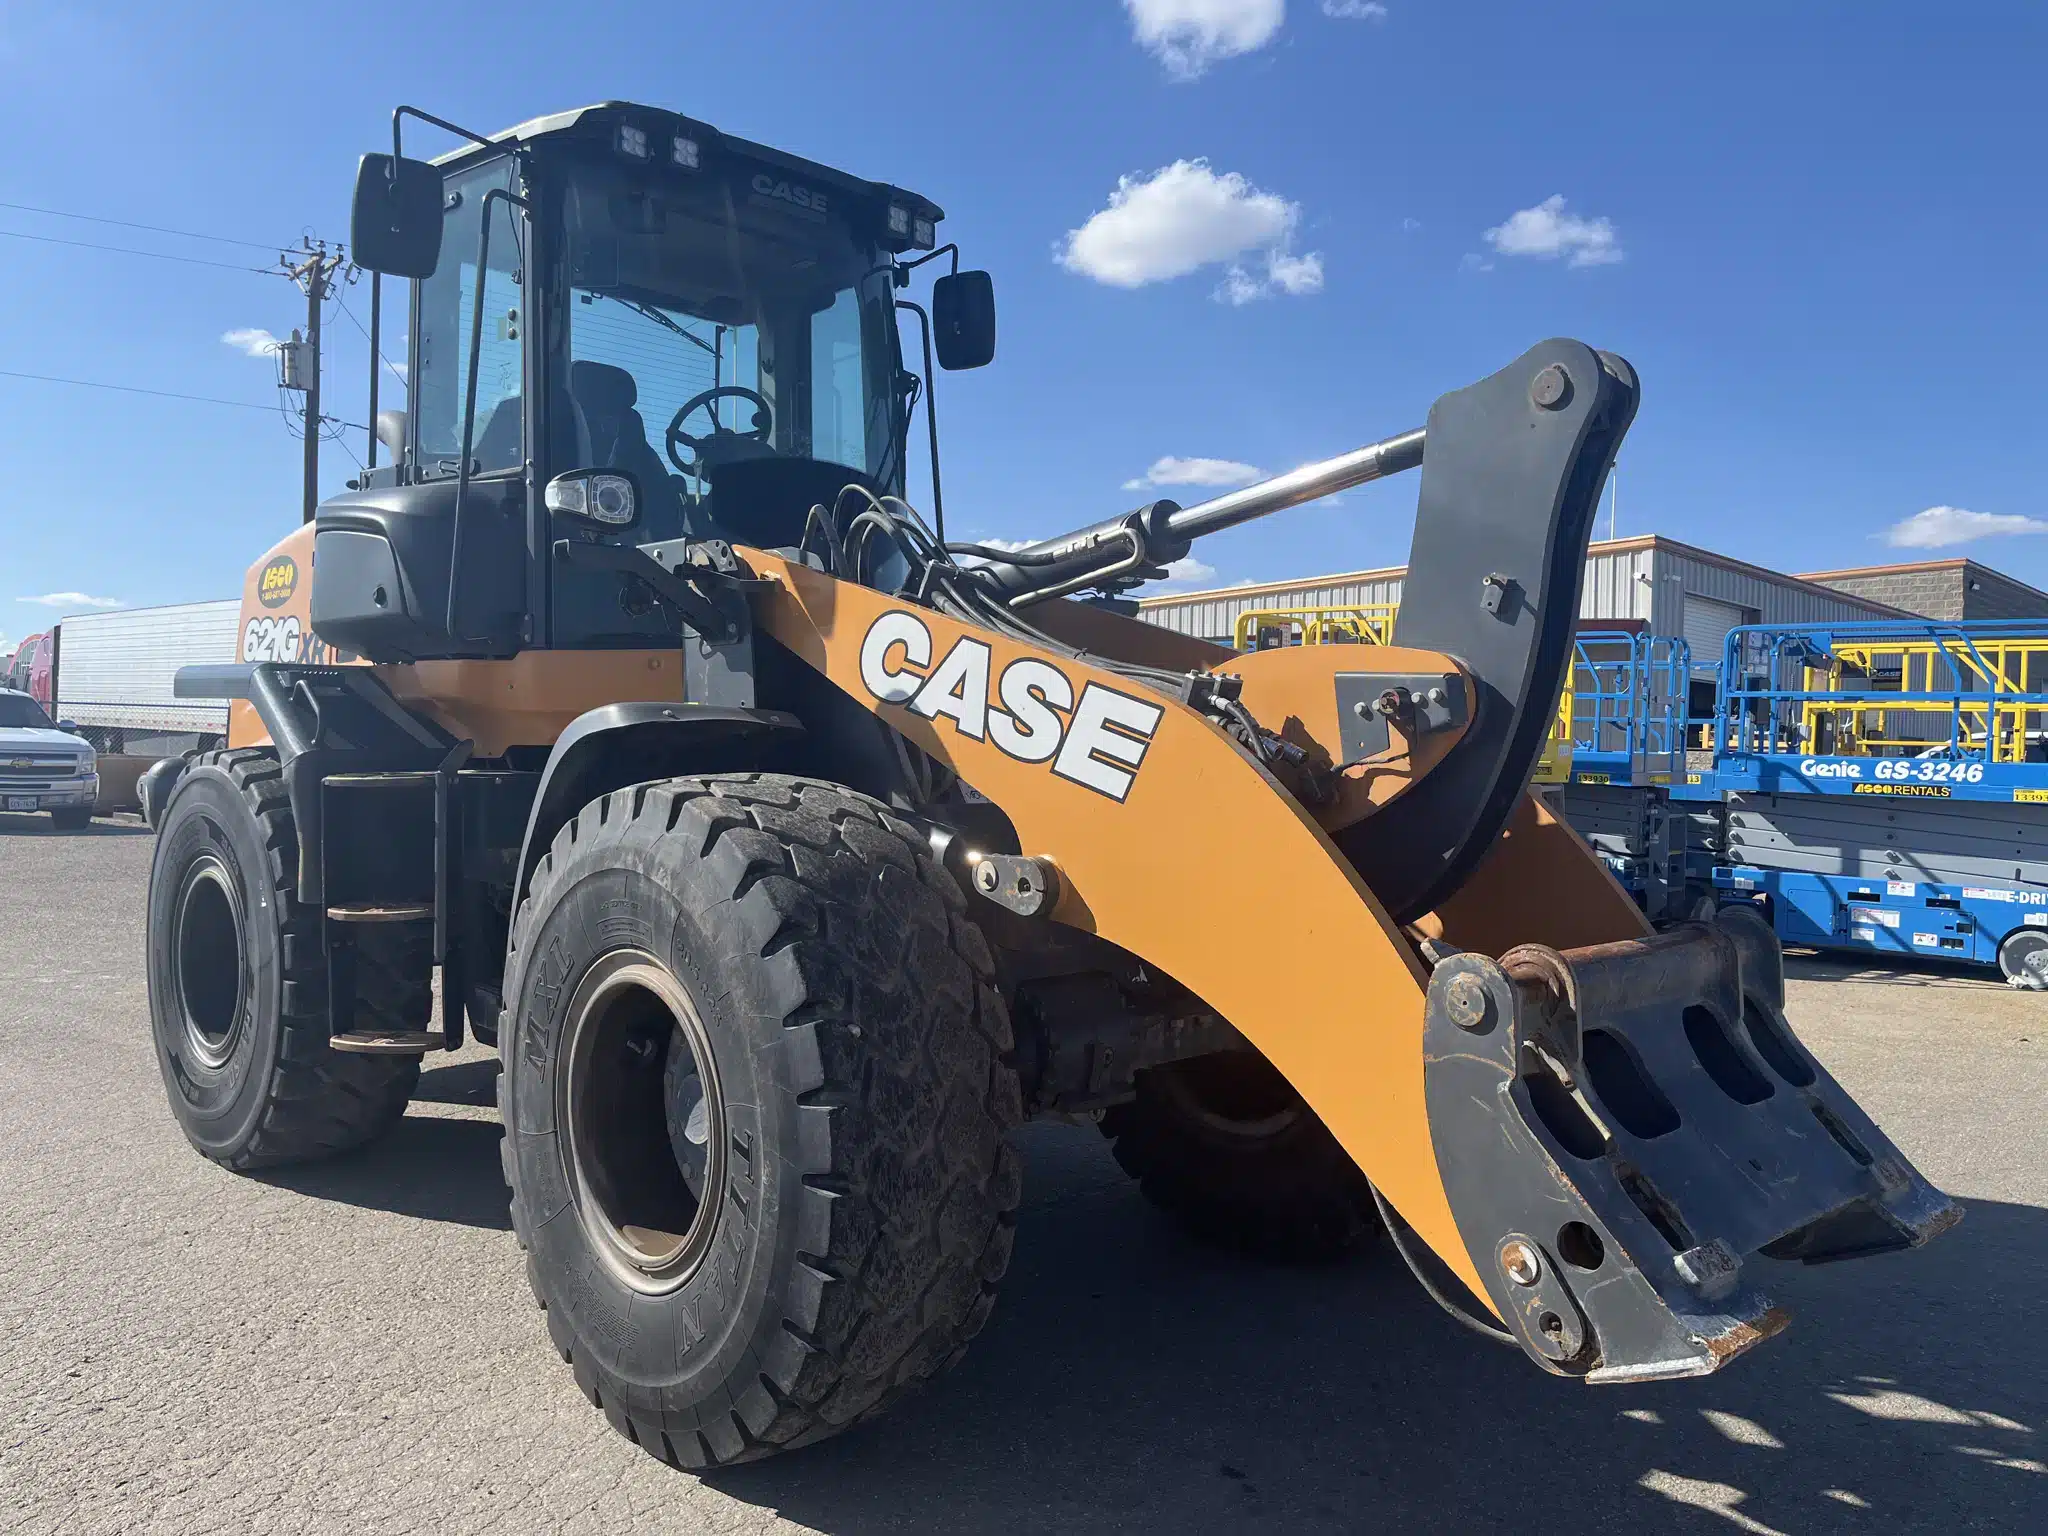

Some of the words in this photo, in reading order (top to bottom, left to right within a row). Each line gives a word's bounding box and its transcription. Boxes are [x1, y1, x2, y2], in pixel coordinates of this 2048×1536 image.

[751, 174, 827, 212] CASE
[243, 615, 300, 662] 621G
[860, 609, 1165, 804] CASE
[1800, 759, 1861, 777] Genie
[1874, 760, 1984, 783] GS-3246
[1894, 785, 1950, 797] RENTALS
[2006, 890, 2048, 906] E-DRI
[681, 1125, 754, 1356] TITAN
